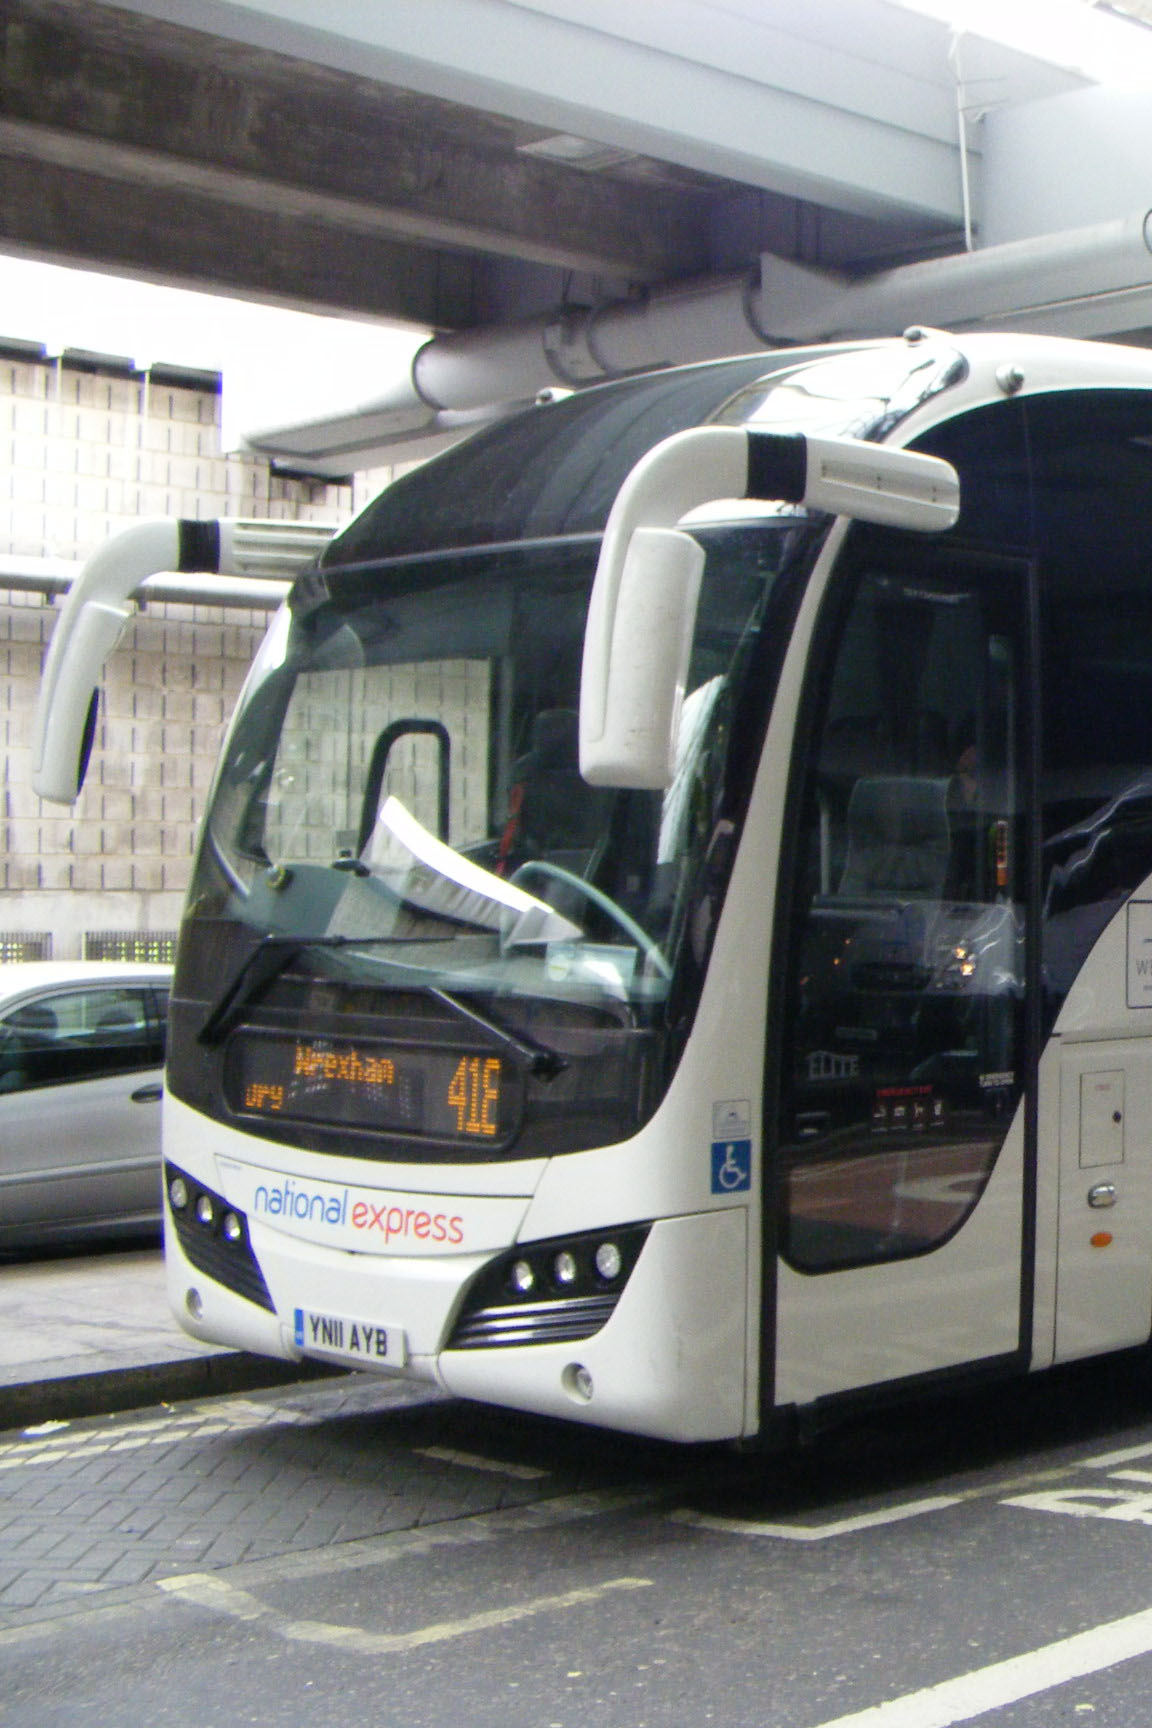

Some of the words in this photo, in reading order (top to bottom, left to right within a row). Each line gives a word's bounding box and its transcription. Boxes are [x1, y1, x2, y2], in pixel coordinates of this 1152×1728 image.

[294, 1045, 395, 1084] Wrexham
[254, 1180, 348, 1225] national
[351, 1201, 464, 1244] express
[309, 1314, 344, 1347] YN11
[349, 1323, 388, 1357] AYB
